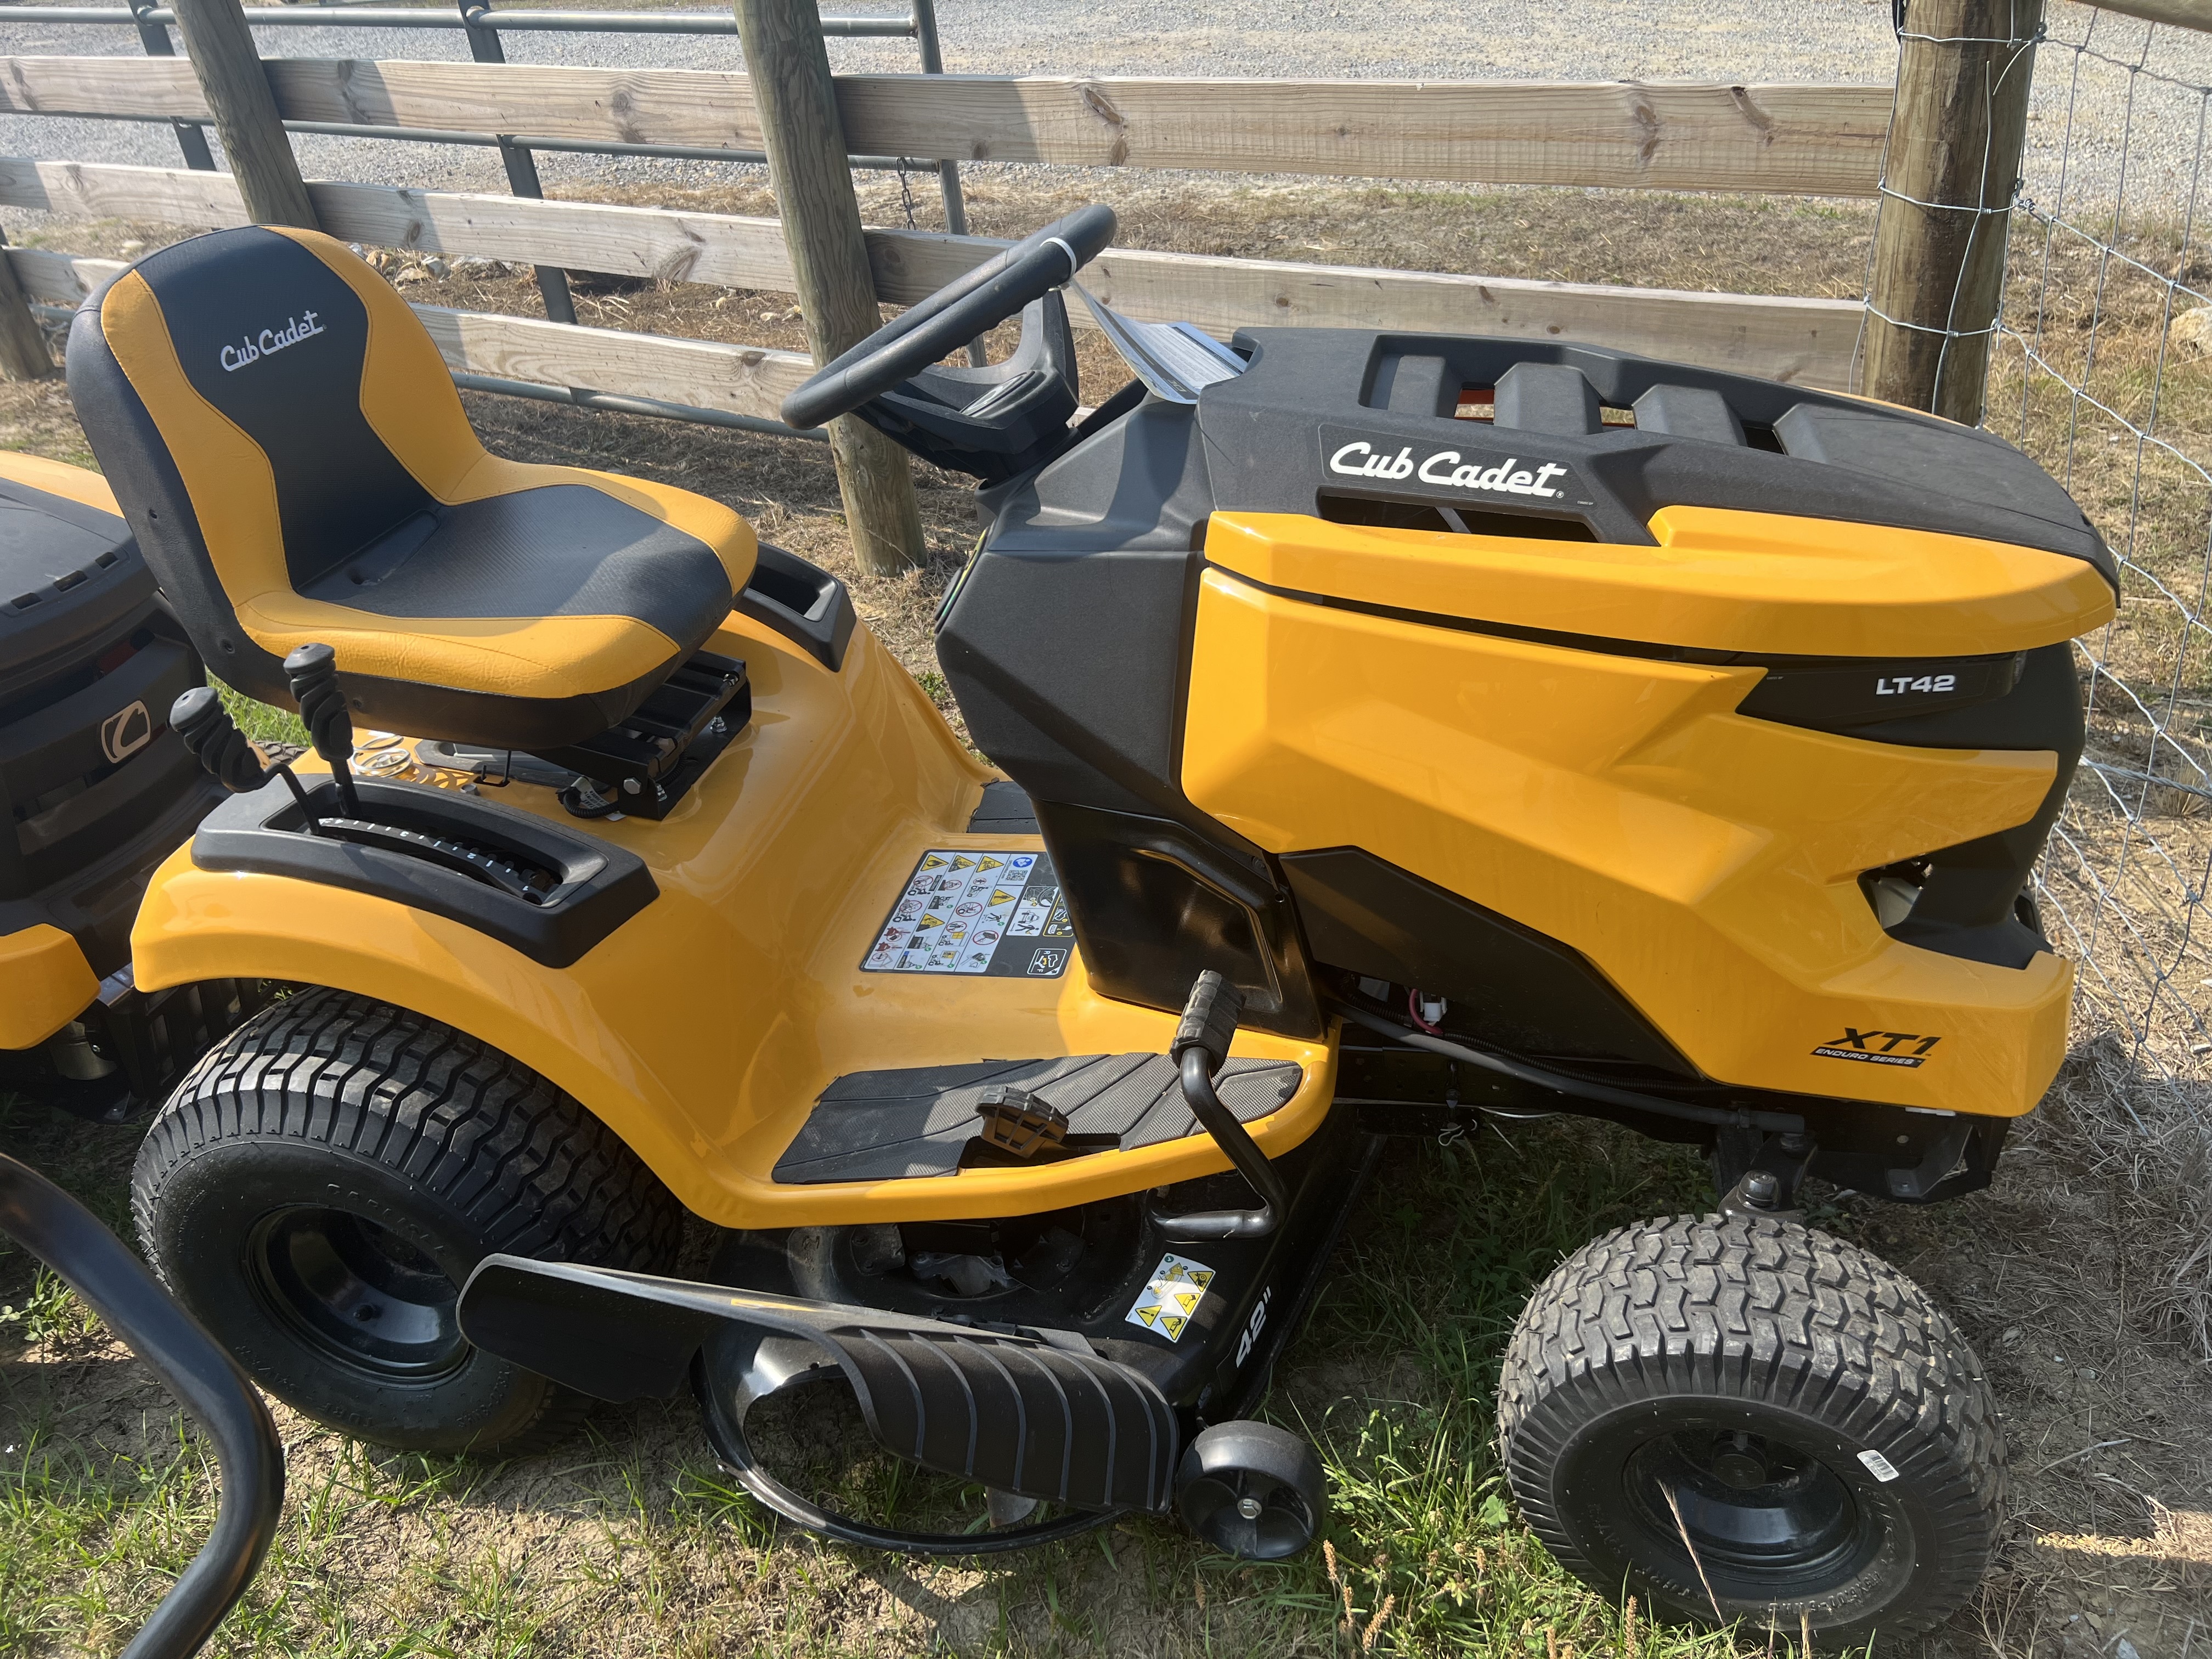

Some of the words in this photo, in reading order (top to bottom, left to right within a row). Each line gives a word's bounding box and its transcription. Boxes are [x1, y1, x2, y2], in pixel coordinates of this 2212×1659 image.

[221, 336, 259, 372] Cub
[258, 310, 325, 356] Cadet
[1329, 442, 1414, 479] Cub
[1418, 451, 1567, 498] Cadet
[1876, 675, 1956, 695] LT42
[1822, 1027, 1942, 1056] XT1
[1815, 1048, 1867, 1060] ENDURO
[1870, 1055, 1914, 1065] SERIES
